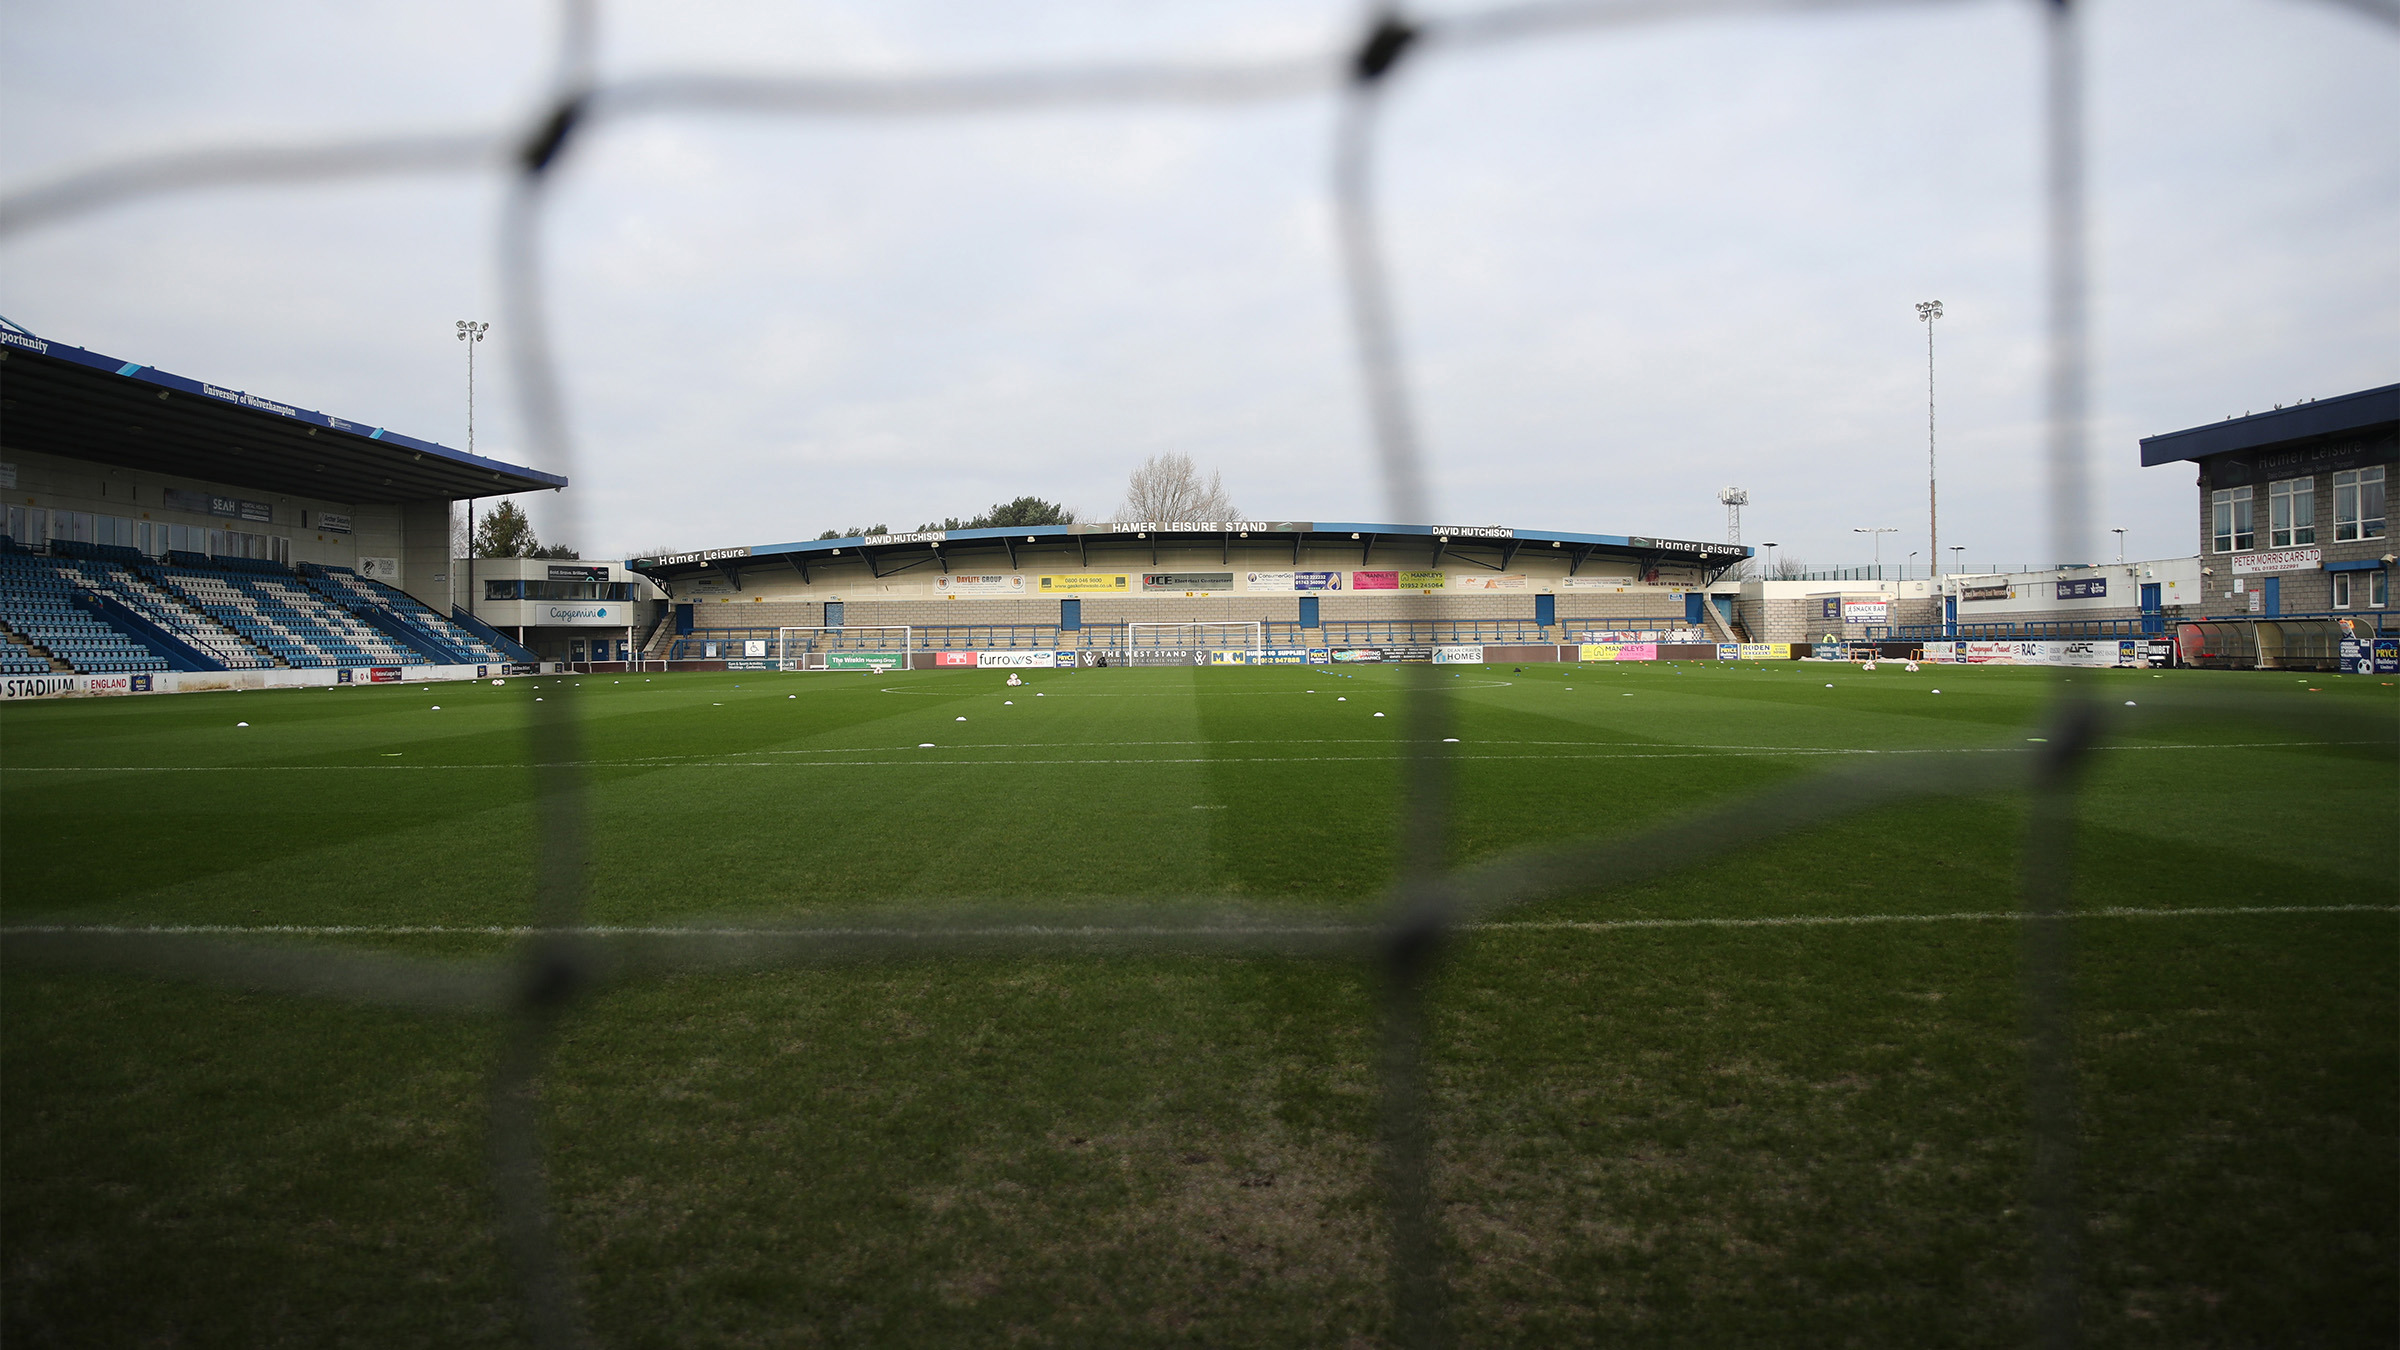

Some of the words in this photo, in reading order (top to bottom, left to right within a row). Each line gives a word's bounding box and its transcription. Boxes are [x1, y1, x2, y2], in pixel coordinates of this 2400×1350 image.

[203, 383, 239, 404] University
[239, 395, 248, 405] of
[247, 396, 296, 416] Wolverhampton
[2258, 450, 2305, 470] Hamer
[2311, 442, 2362, 460] Leisure
[213, 498, 235, 512] SEAH
[1112, 522, 1157, 533] HAMER
[1164, 522, 1217, 532] LEISURE
[1225, 522, 1267, 532] STAND
[1432, 527, 1459, 535] DAVID
[1461, 528, 1513, 538] HUTCHISON
[865, 536, 892, 545] DAVID
[894, 532, 946, 542] HUTCHISON
[1655, 540, 1697, 551] Hamer
[659, 553, 700, 565] Hamer
[2234, 555, 2256, 567] PETER
[2256, 552, 2283, 566] MORRIS
[2284, 550, 2304, 563] CARS
[2305, 549, 2320, 561] LTD
[1146, 576, 1172, 585] JCE
[550, 607, 596, 622] Capgemini
[1994, 642, 2011, 653] Travel
[2021, 643, 2037, 656] RAC
[2069, 643, 2093, 653] APC
[2148, 645, 2170, 654] UNIBET
[2376, 649, 2398, 658] PRYCE
[979, 653, 1033, 665] furrows
[1213, 652, 1244, 664] MKM
[1447, 652, 1482, 660] HOMES
[8, 678, 74, 697] STADIUM
[91, 679, 127, 689] ENGLAND
